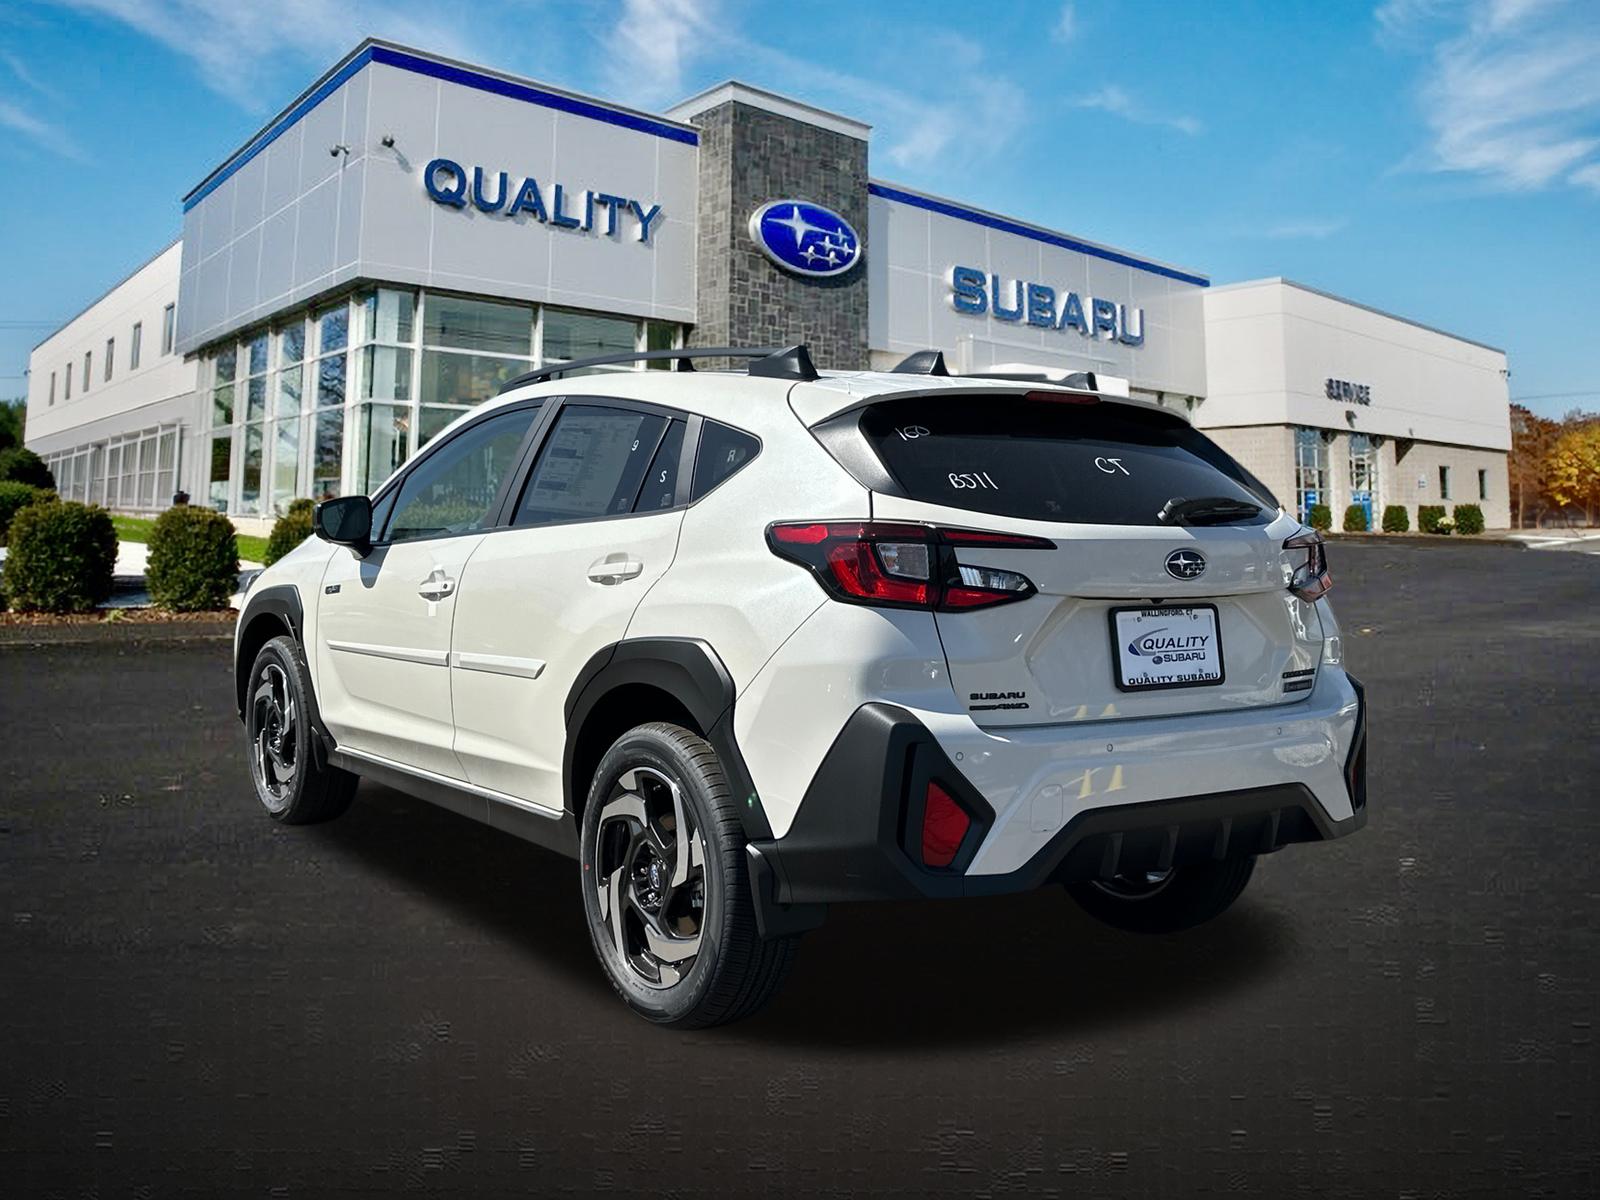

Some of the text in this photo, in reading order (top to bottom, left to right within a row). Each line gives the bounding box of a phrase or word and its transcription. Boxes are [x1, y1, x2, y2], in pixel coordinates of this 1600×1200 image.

[424, 158, 661, 242] QUALITY
[952, 265, 1145, 346] SUBARU
[1095, 456, 1130, 476] CT
[1143, 636, 1208, 650] QUALITY
[1163, 652, 1206, 663] SUBARU
[1128, 672, 1219, 684] QUALITY SUBARU
[970, 692, 1025, 700] SUBARU
